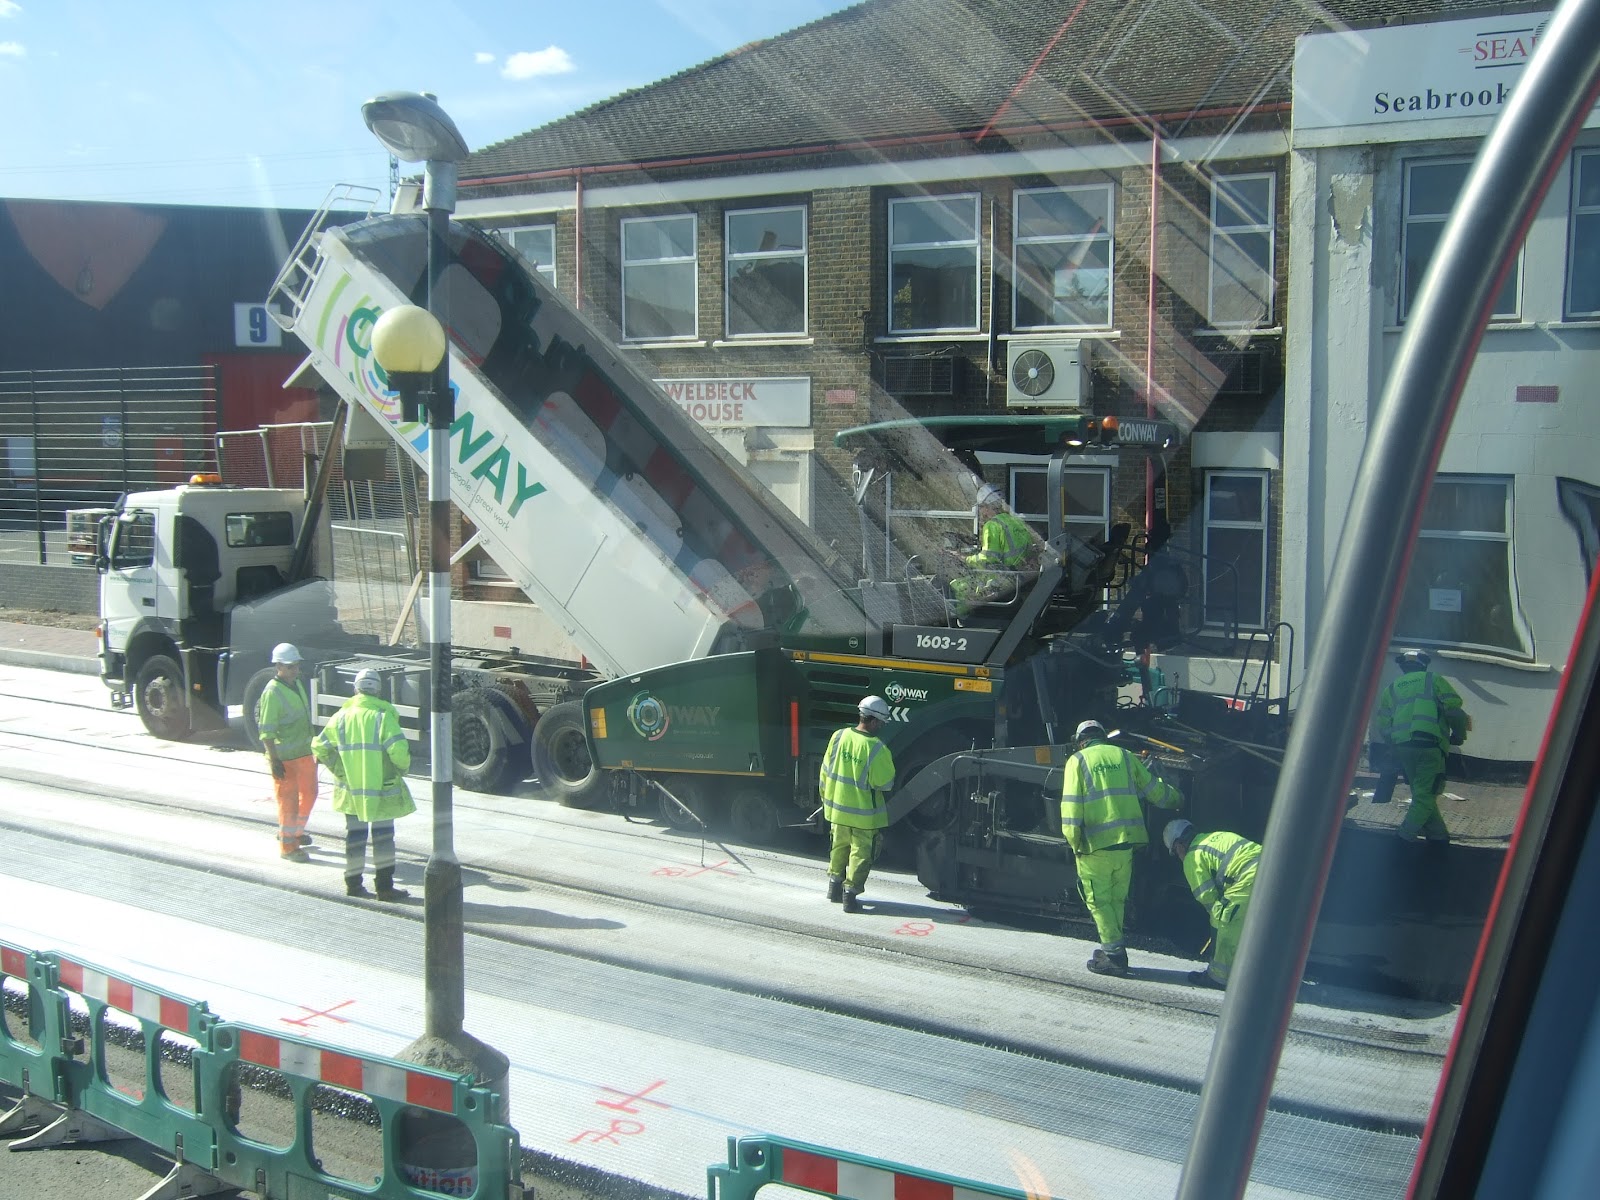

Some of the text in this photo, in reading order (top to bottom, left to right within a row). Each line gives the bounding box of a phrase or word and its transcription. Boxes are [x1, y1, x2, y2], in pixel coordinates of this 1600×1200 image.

[248, 306, 269, 344] 9
[663, 383, 757, 401] WELBECK
[1118, 422, 1158, 442] CONWAY
[474, 494, 494, 514] great
[493, 511, 511, 532] work
[916, 634, 968, 651] 1603-2
[884, 686, 929, 699] CONWAY
